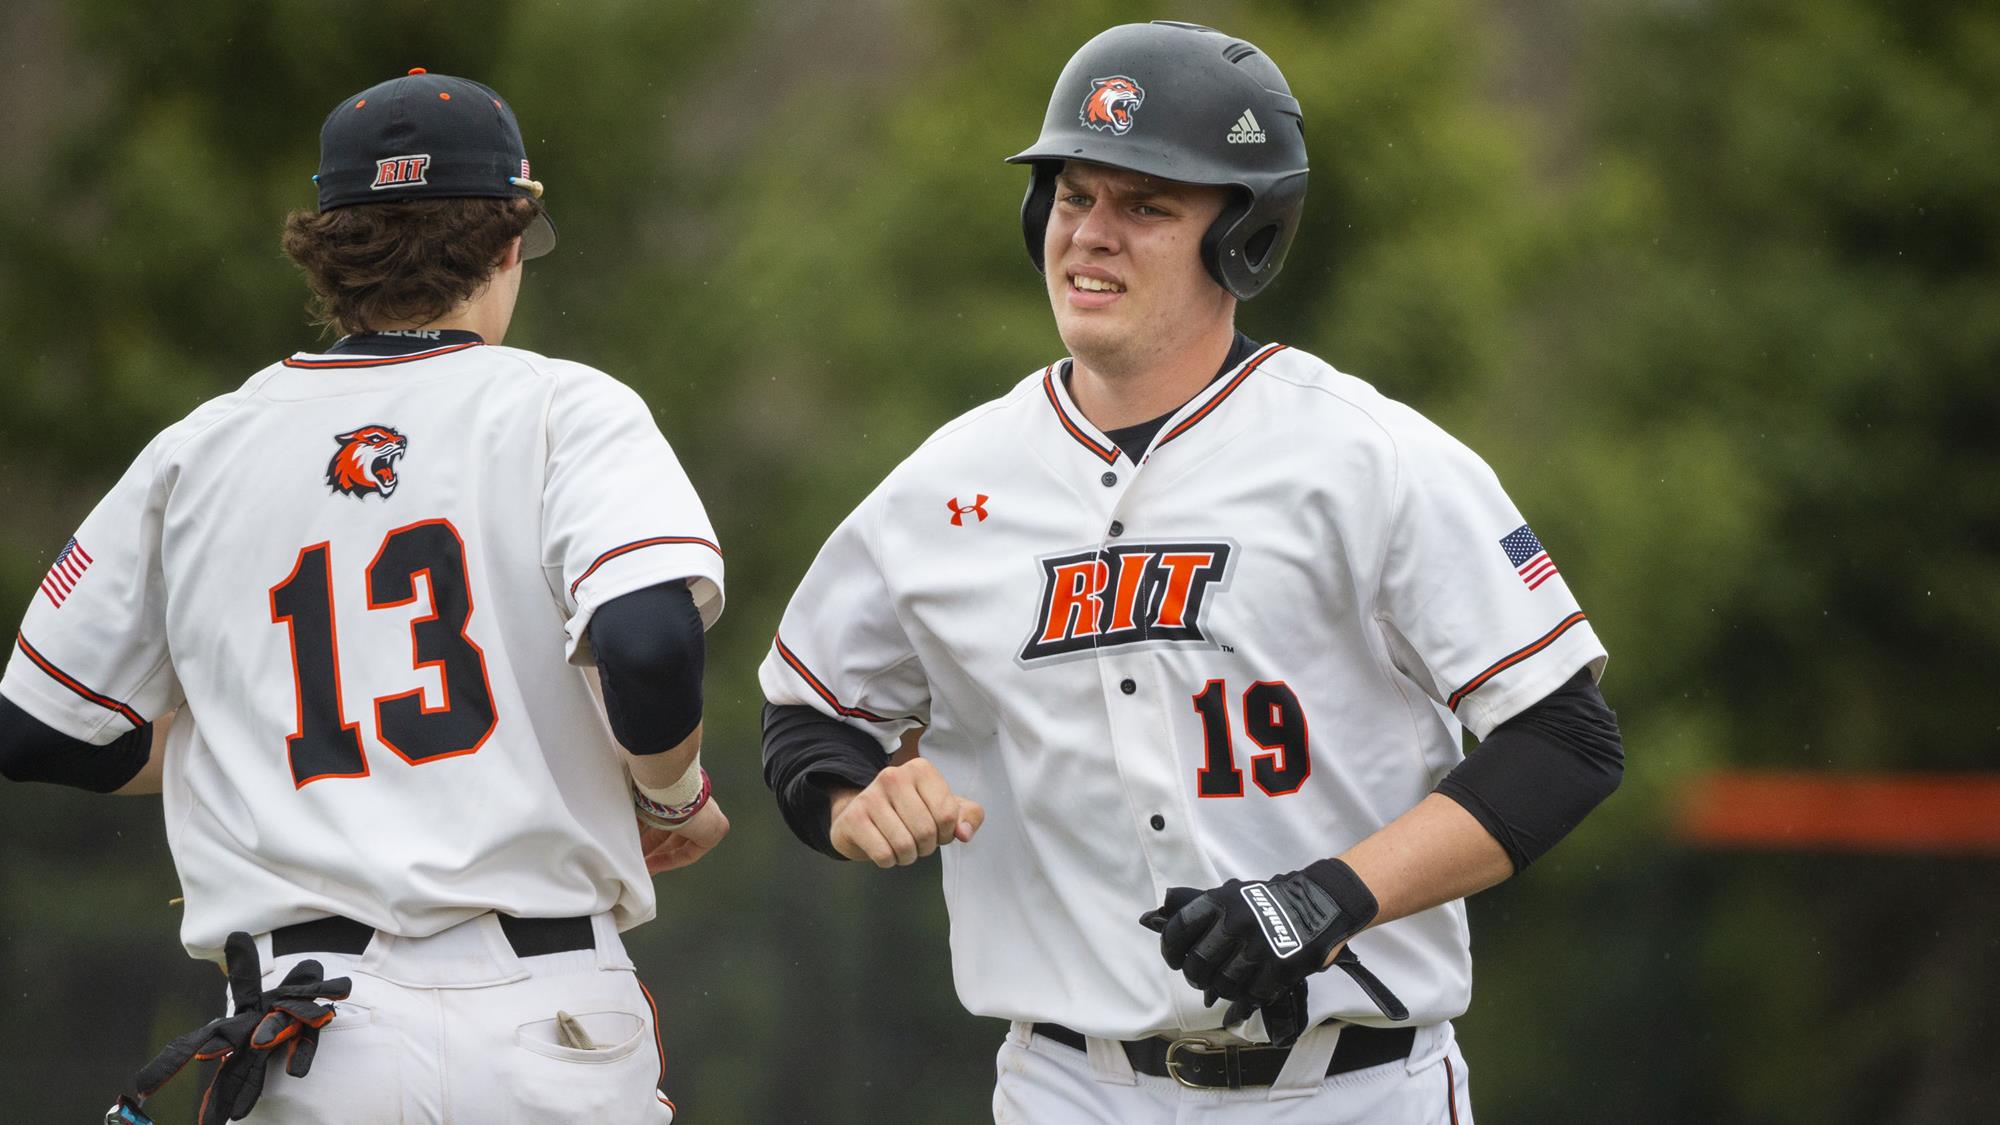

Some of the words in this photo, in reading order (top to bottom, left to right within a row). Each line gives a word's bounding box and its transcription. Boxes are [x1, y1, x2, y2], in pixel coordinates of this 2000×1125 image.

[376, 157, 426, 186] RIT
[1227, 131, 1266, 144] adidas
[1034, 550, 1219, 647] RIT
[269, 517, 499, 790] 13
[1192, 679, 1311, 798] 19
